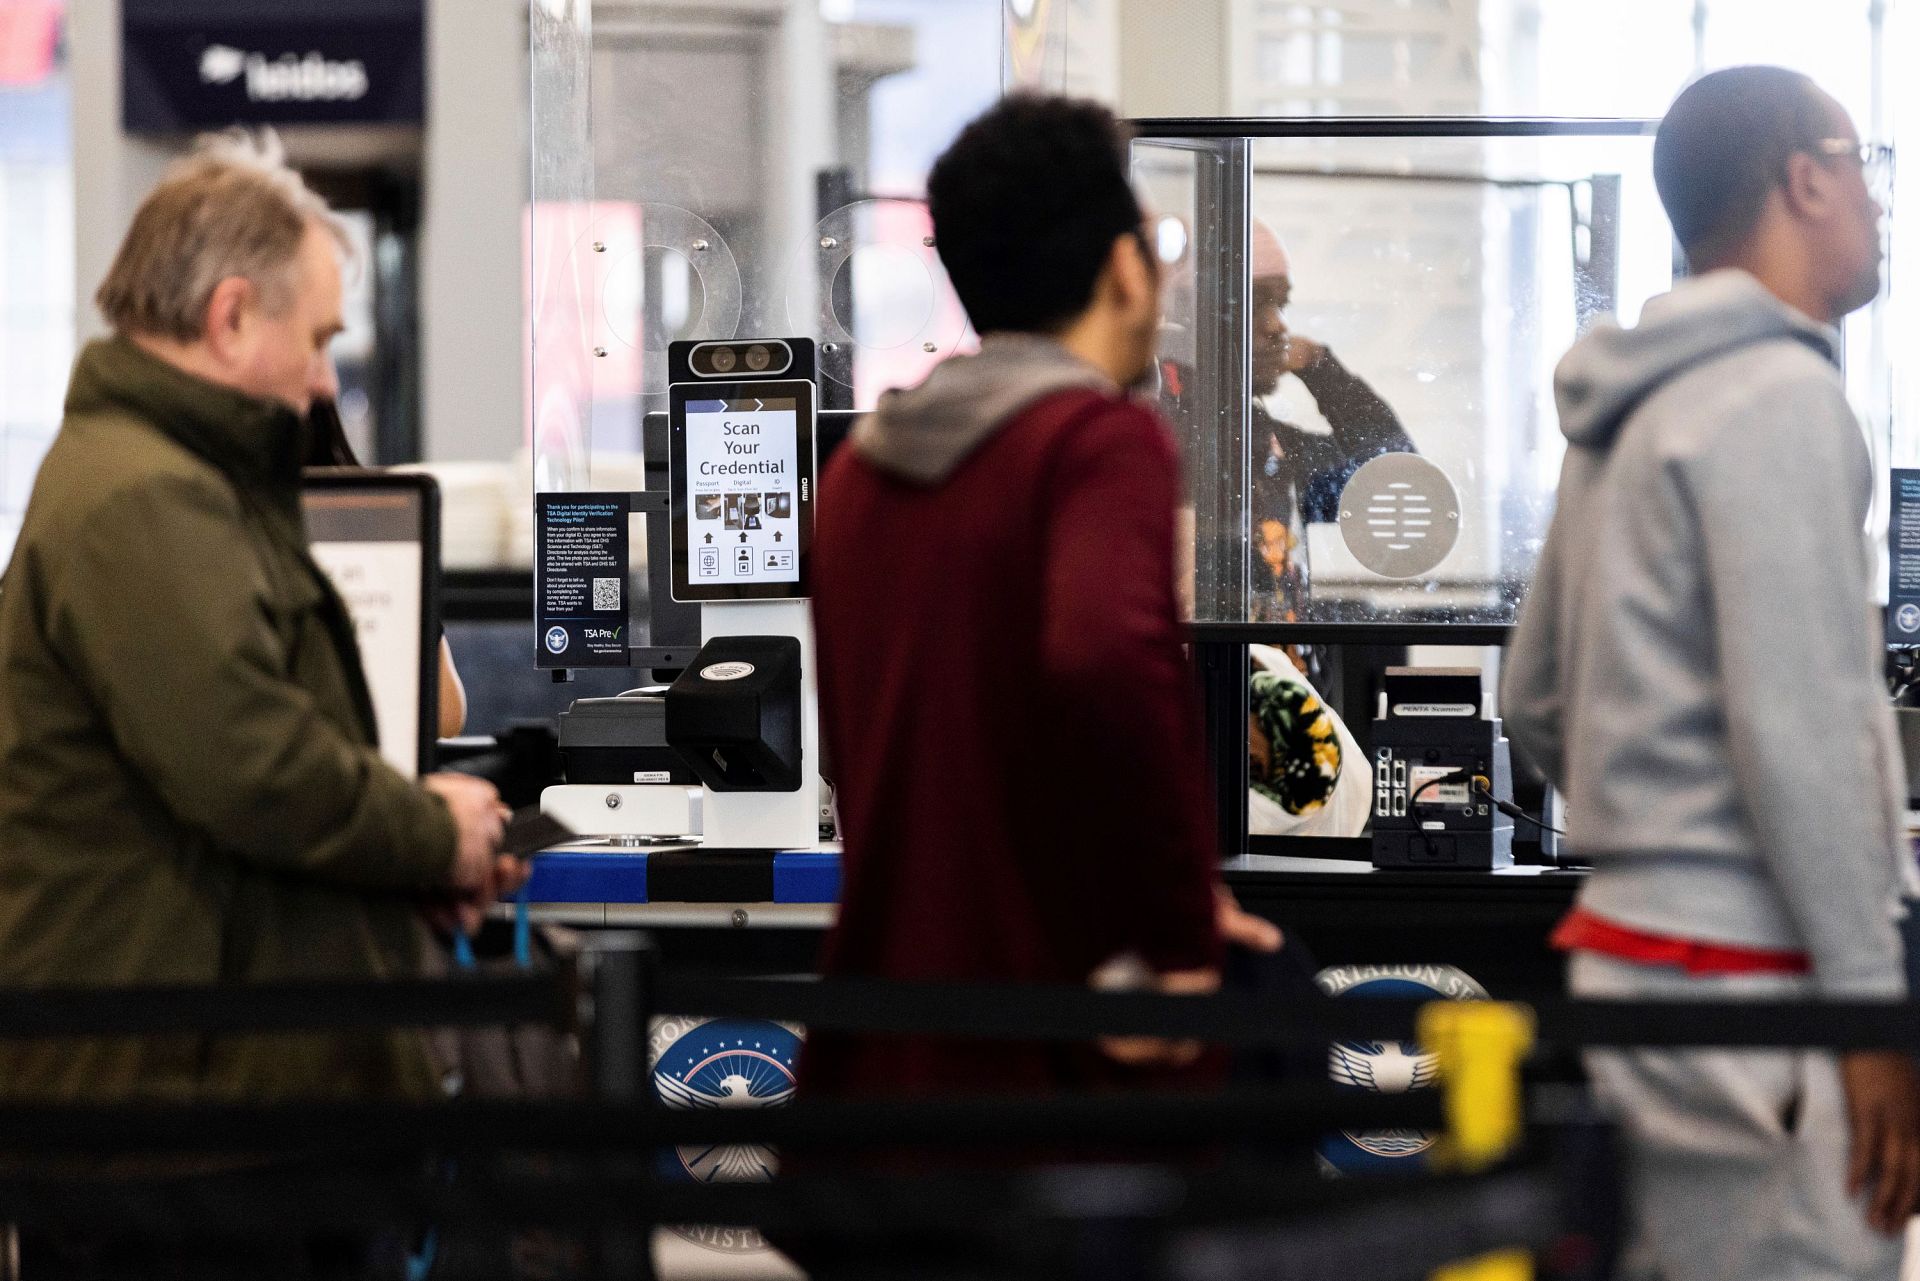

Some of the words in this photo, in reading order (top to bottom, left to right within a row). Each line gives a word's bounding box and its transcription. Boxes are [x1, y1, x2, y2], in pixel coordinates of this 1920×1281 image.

[723, 421, 760, 436] Scan
[724, 440, 760, 455] Your
[700, 459, 785, 475] Credential
[801, 477, 809, 502] mimo
[584, 629, 598, 638] TSA
